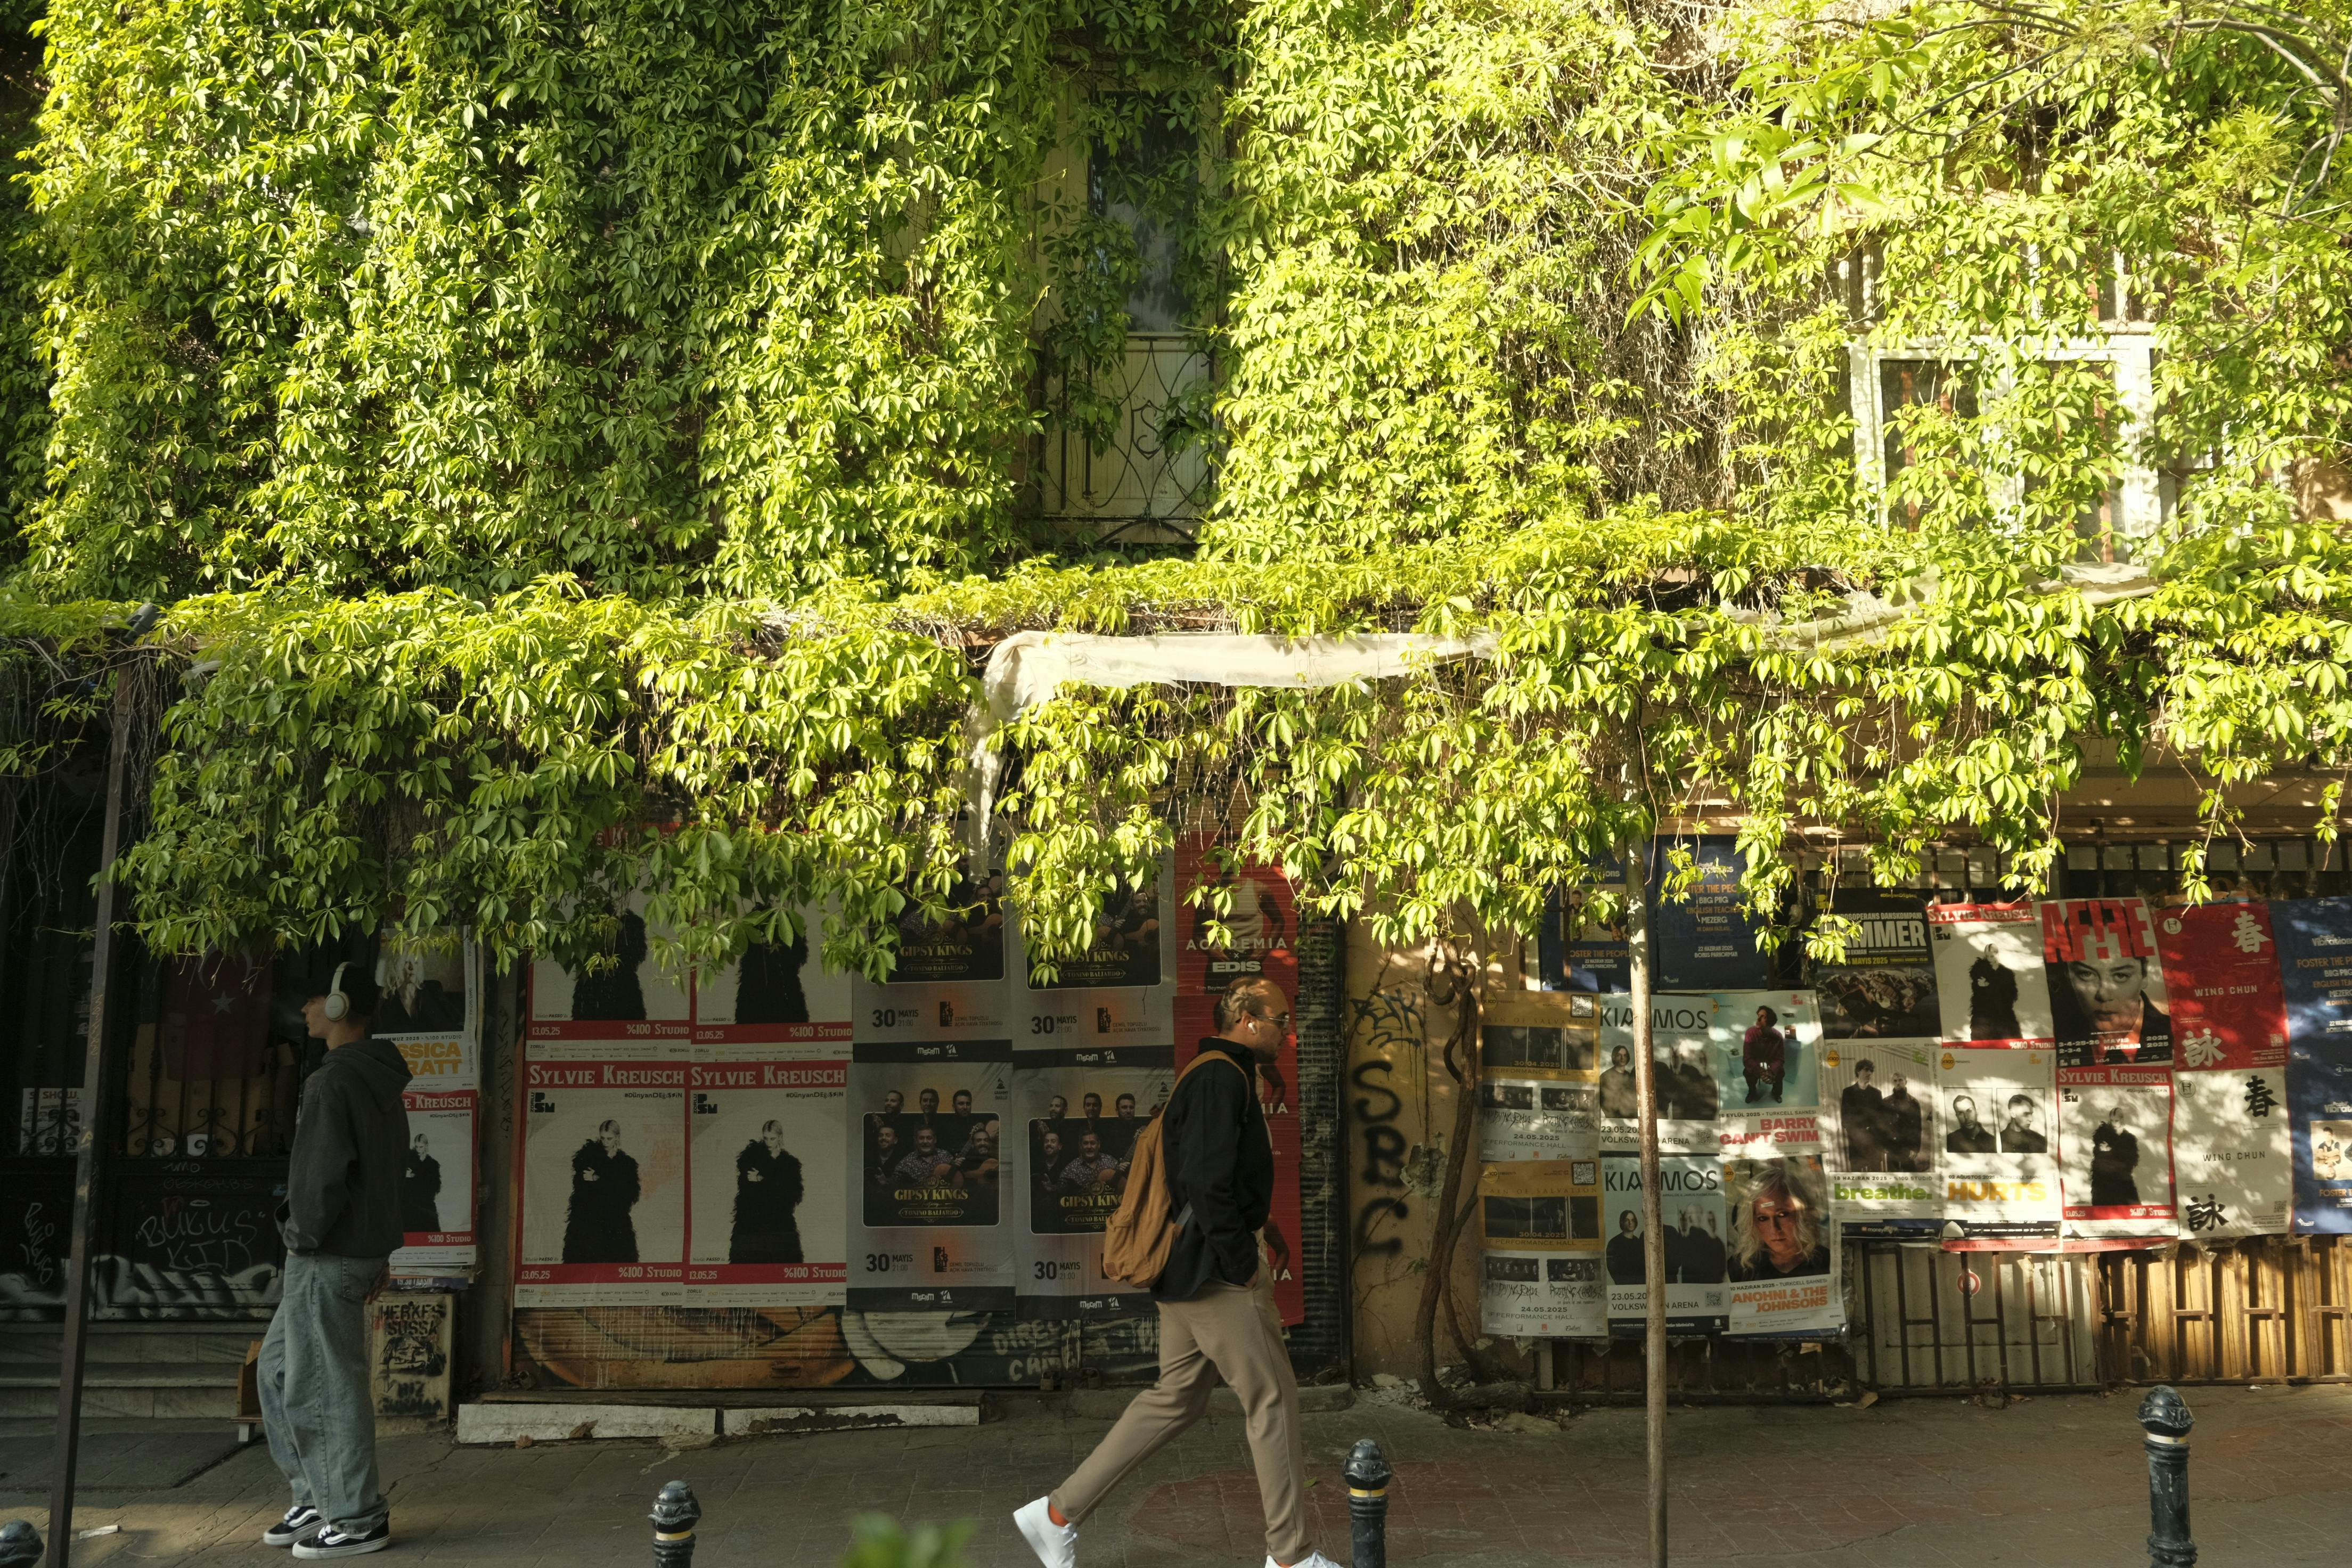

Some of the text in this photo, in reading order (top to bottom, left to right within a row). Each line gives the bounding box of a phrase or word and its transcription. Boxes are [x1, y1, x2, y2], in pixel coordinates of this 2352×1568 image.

[1706, 884, 1720, 893] THE
[1928, 909, 1975, 921] SYLVIE
[2232, 911, 2272, 953] 春
[900, 945, 973, 957] GIPSY KINGS
[1094, 950, 1130, 962] KINGS
[2297, 957, 2344, 968] FOSTER THE
[2194, 985, 2258, 997] WING CHUN
[872, 1009, 896, 1028] 30
[1031, 1015, 1077, 1034] 30 MAYIS
[1600, 1007, 1708, 1030] KIAMOS
[532, 1024, 690, 1035] 13.05.25 %100 STUDIO
[696, 1026, 853, 1040] 13.05.25 %100 STUDIO
[2182, 1027, 2227, 1067] 詠
[407, 1058, 463, 1076] RATT
[529, 1065, 685, 1084] SYLVIE KREUSCH
[691, 1065, 846, 1086] SYLVIE KREUSCH
[2059, 1068, 2168, 1083] SYLVIE KREUSCH
[415, 1095, 472, 1109] KREUSCH
[2244, 1075, 2281, 1118] 春
[1760, 1116, 1817, 1130] BARRY
[1490, 1139, 1546, 1148] PERFORMANCE
[1720, 1130, 1819, 1145] CAN'T SWIM
[2203, 1151, 2266, 1162] WING CHUN
[1605, 1170, 1718, 1191] KIAMOS
[895, 1188, 969, 1200] GIPSY KINGS
[1834, 1183, 1933, 1200] breathe.
[1948, 1182, 2047, 1202] HURTS
[2319, 1188, 2347, 1197] FOSTER
[1060, 1195, 1123, 1207] GIPSY KIN
[2185, 1193, 2230, 1232] 詠
[428, 1235, 444, 1243] %100
[866, 1253, 913, 1272] 30 MAYIS
[521, 1265, 682, 1280] 13.05.25 %100 STUDIO
[689, 1267, 847, 1280] 13.05.25 %100 STUDIO
[1034, 1261, 1081, 1280] 30 MAYIS
[1732, 1285, 1827, 1304] ANOHNI & THE
[1671, 1301, 1699, 1309] ARENA
[1755, 1296, 1828, 1313] JOHNSONS
